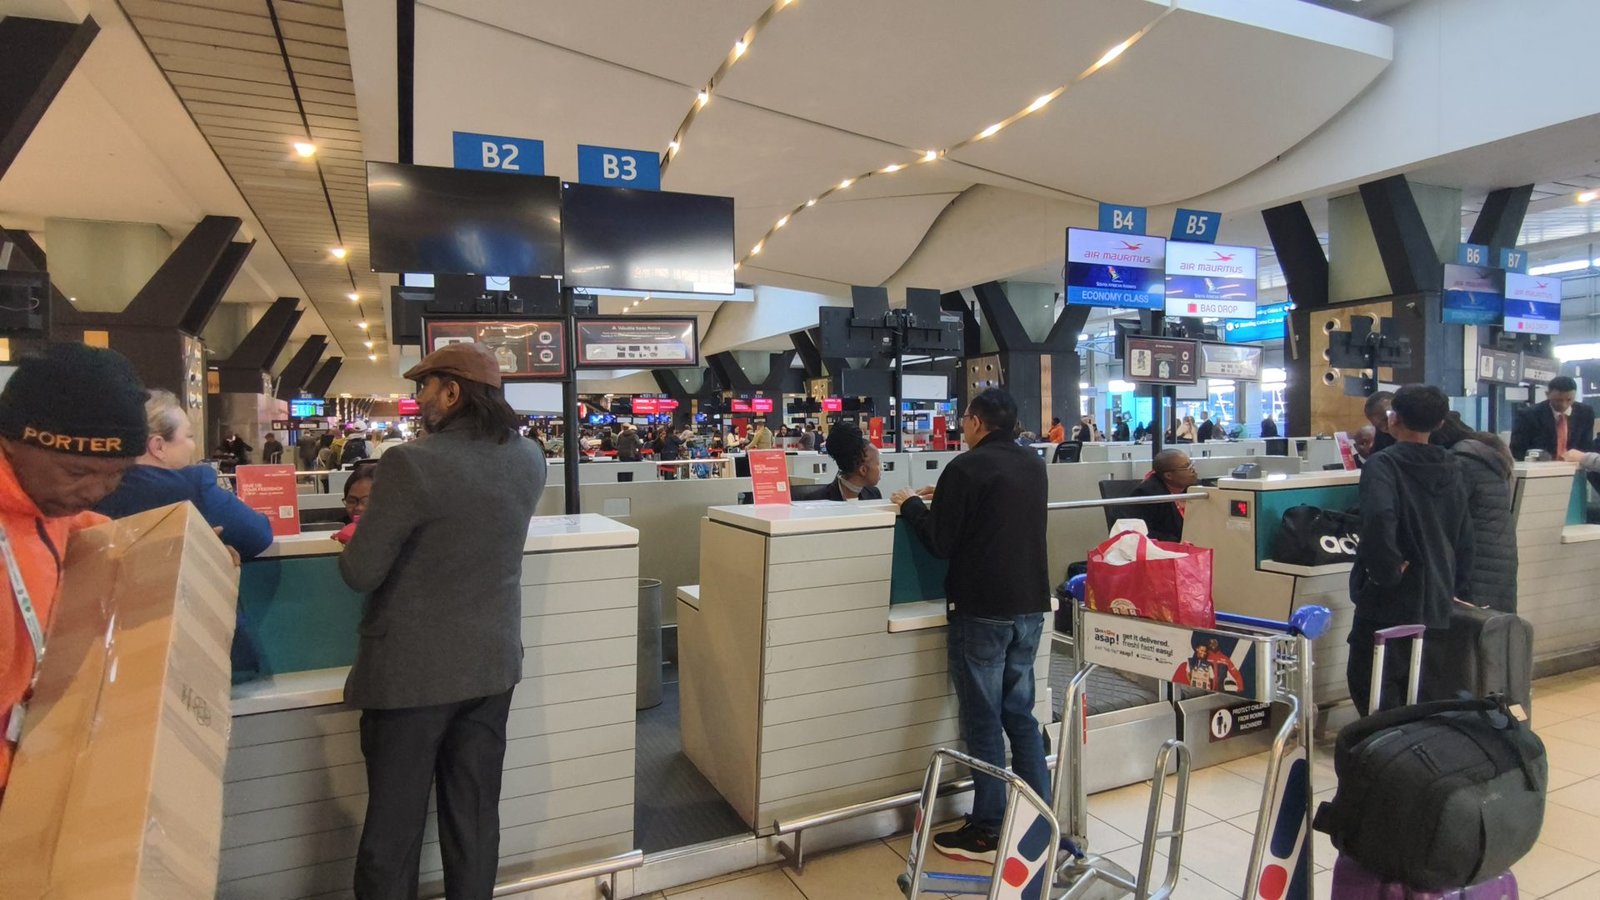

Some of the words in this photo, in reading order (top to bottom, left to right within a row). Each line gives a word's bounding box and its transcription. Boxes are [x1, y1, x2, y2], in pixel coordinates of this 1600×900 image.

[481, 141, 520, 171] B2
[602, 153, 638, 182] B3
[1113, 209, 1134, 230] B4
[1186, 214, 1207, 235] B5
[1466, 248, 1480, 264] B6
[1508, 253, 1521, 269] B7
[1082, 290, 1122, 302] ECONOMY
[1123, 294, 1149, 303] CLASS
[1200, 303, 1216, 313] BAG
[1217, 304, 1238, 314] DROP
[23, 426, 122, 452] PORTER
[1094, 633, 1119, 646] asap!
[1122, 633, 1133, 642] get
[1139, 635, 1170, 648] delivered.
[1122, 640, 1139, 649] fresh!
[1140, 644, 1155, 653] fast!
[1155, 647, 1174, 658] easy!
[1232, 705, 1251, 715] PROTECT
[1250, 701, 1271, 711] CHILDREN
[1237, 714, 1249, 722] FROM
[1249, 710, 1265, 720] MOVING
[1239, 719, 1263, 730] MACHINERY
